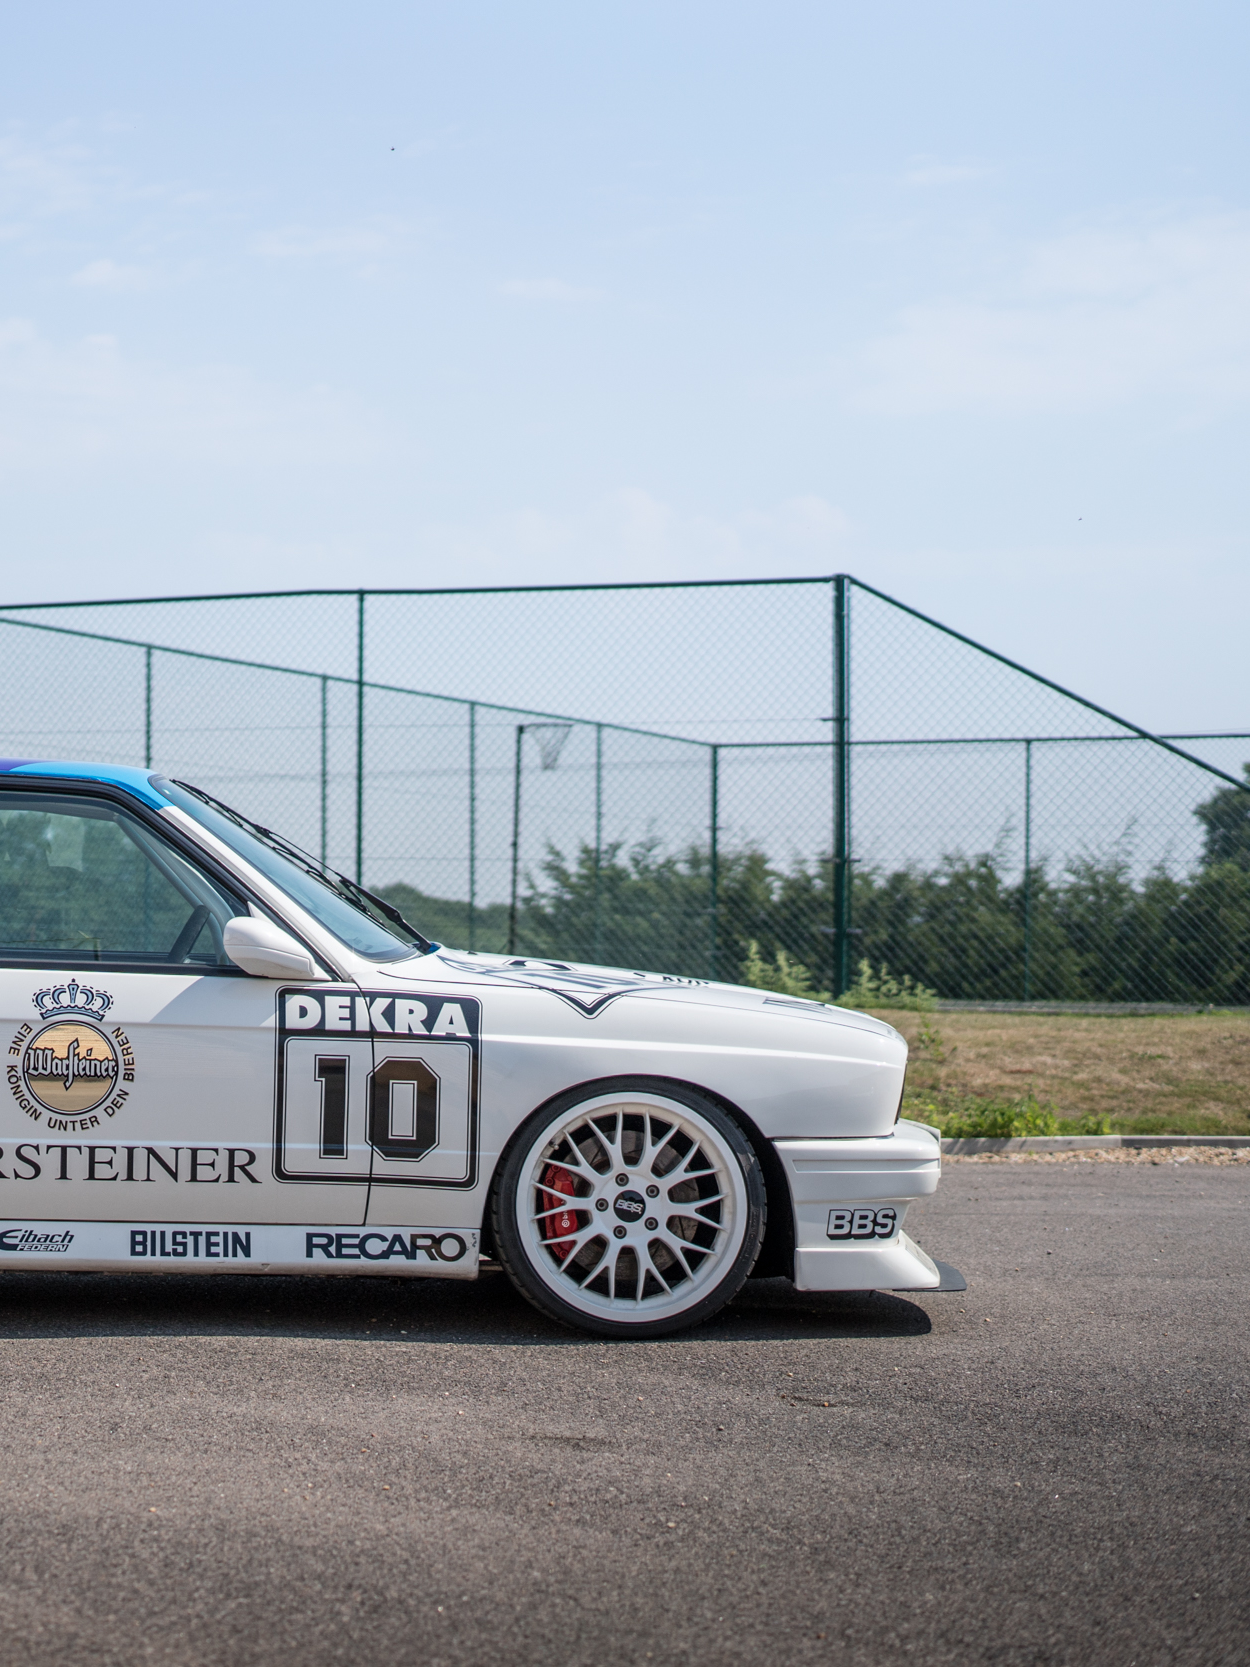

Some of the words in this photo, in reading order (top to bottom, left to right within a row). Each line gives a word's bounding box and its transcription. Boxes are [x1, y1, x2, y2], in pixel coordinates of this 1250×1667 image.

[284, 994, 472, 1037] DEKRA
[8, 1022, 33, 1057] EINE
[111, 1026, 136, 1082] BIEREN
[6, 1064, 42, 1121] KÖNIGIN
[103, 1088, 130, 1118] DEN
[314, 1054, 441, 1163] 10
[47, 1114, 101, 1132] UNTER
[615, 1199, 644, 1214] BBS
[826, 1207, 897, 1241] BBS
[16, 1244, 68, 1252] FEDERN
[130, 1230, 251, 1258] BILSTEIN
[305, 1232, 467, 1262] RECARO
